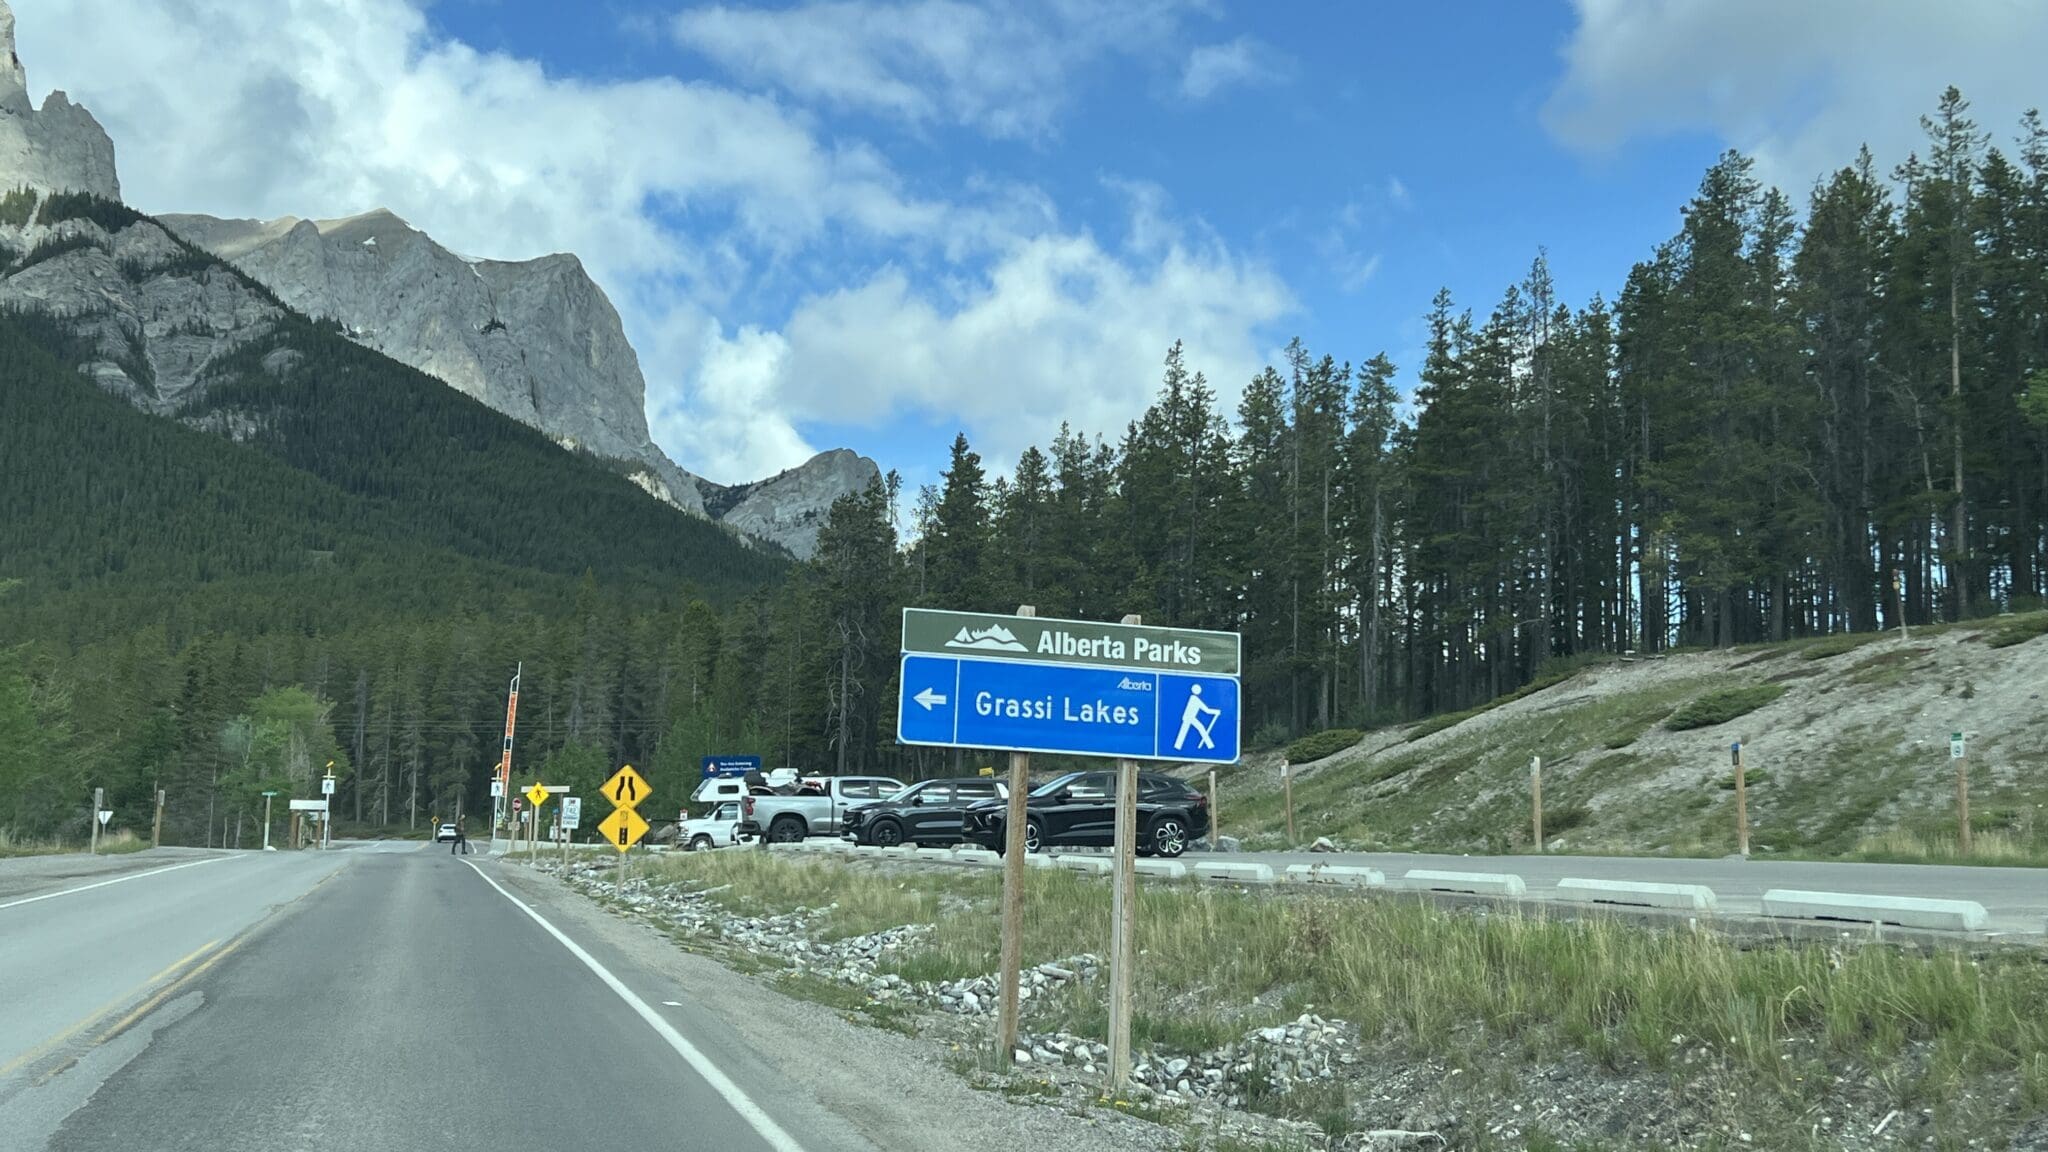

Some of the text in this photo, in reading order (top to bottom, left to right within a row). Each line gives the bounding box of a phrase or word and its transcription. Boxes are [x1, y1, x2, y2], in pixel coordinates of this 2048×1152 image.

[1036, 630, 1201, 665] Alberta Parks
[975, 691, 1139, 726] Grassi Lakes
